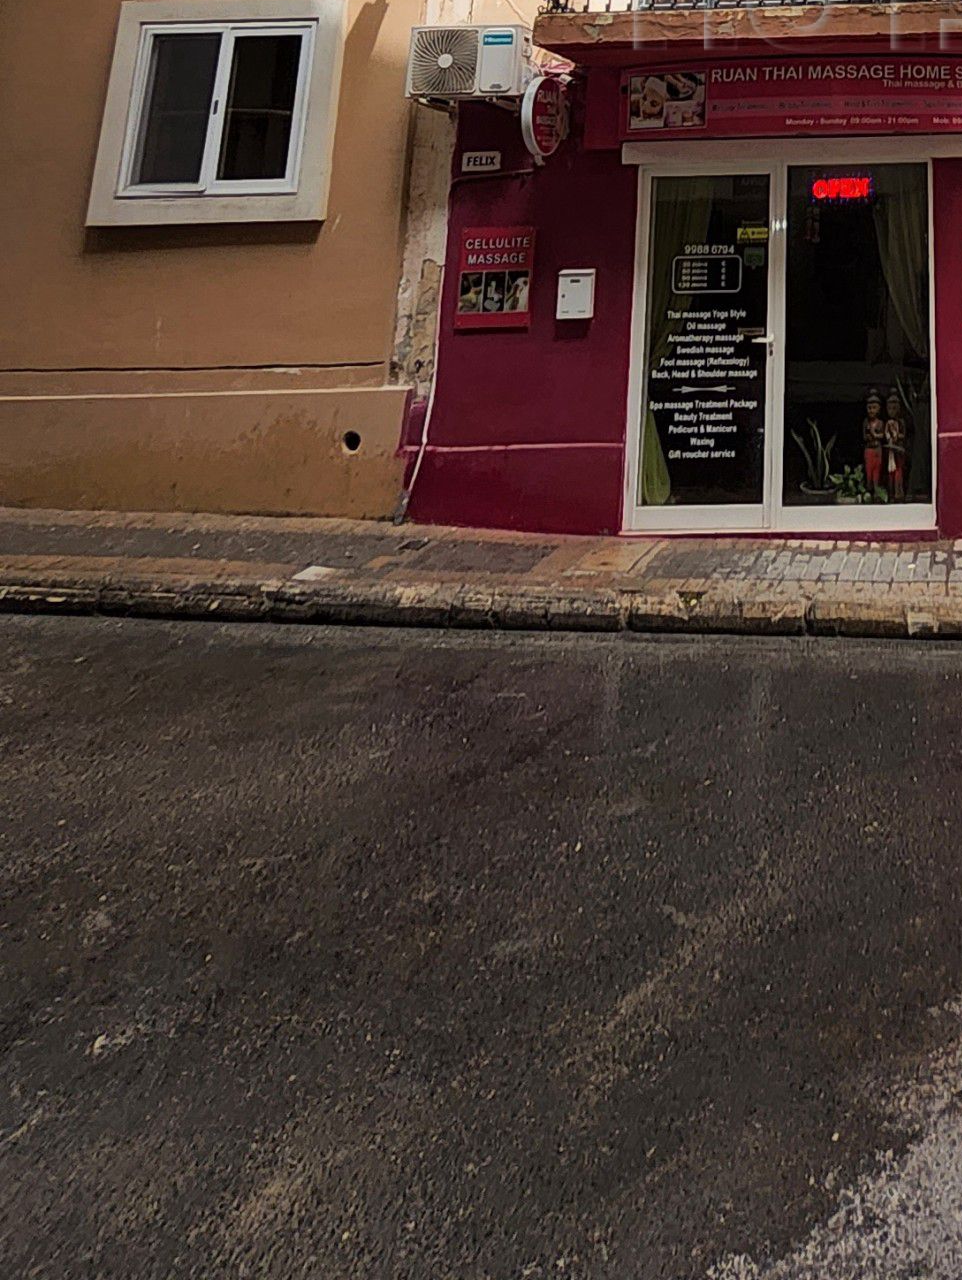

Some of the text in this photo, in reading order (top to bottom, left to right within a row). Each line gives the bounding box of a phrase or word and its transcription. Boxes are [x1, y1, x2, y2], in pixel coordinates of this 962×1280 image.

[711, 67, 758, 83] RUAN
[762, 66, 803, 81] THAI
[808, 65, 895, 80] MASSAGE
[900, 65, 951, 80] HOME
[882, 79, 903, 89] Thai
[904, 80, 946, 91] massage
[947, 80, 955, 89] &
[466, 155, 497, 167] FELIX
[813, 178, 869, 199] OPEN
[465, 236, 531, 250] CELLULITE
[467, 252, 526, 265] MASSAGE
[667, 308, 747, 320] Thai massage Yoga Style
[686, 322, 726, 331] Oil massage
[667, 334, 744, 343] Aromatherapy massage
[677, 345, 735, 355] Swedish massage
[660, 357, 676, 367] Foot
[676, 358, 706, 367] massage
[671, 370, 689, 378] Head
[697, 369, 728, 378] Shoulder
[728, 369, 758, 379] massage
[664, 401, 694, 411] massage
[694, 400, 728, 409] Treatment
[729, 399, 758, 410] Package
[674, 412, 733, 423] Beauty Treatment
[668, 424, 737, 434] Pedicure & Manicure
[690, 437, 715, 448] Waxing
[668, 449, 736, 459] Gift voucher service
